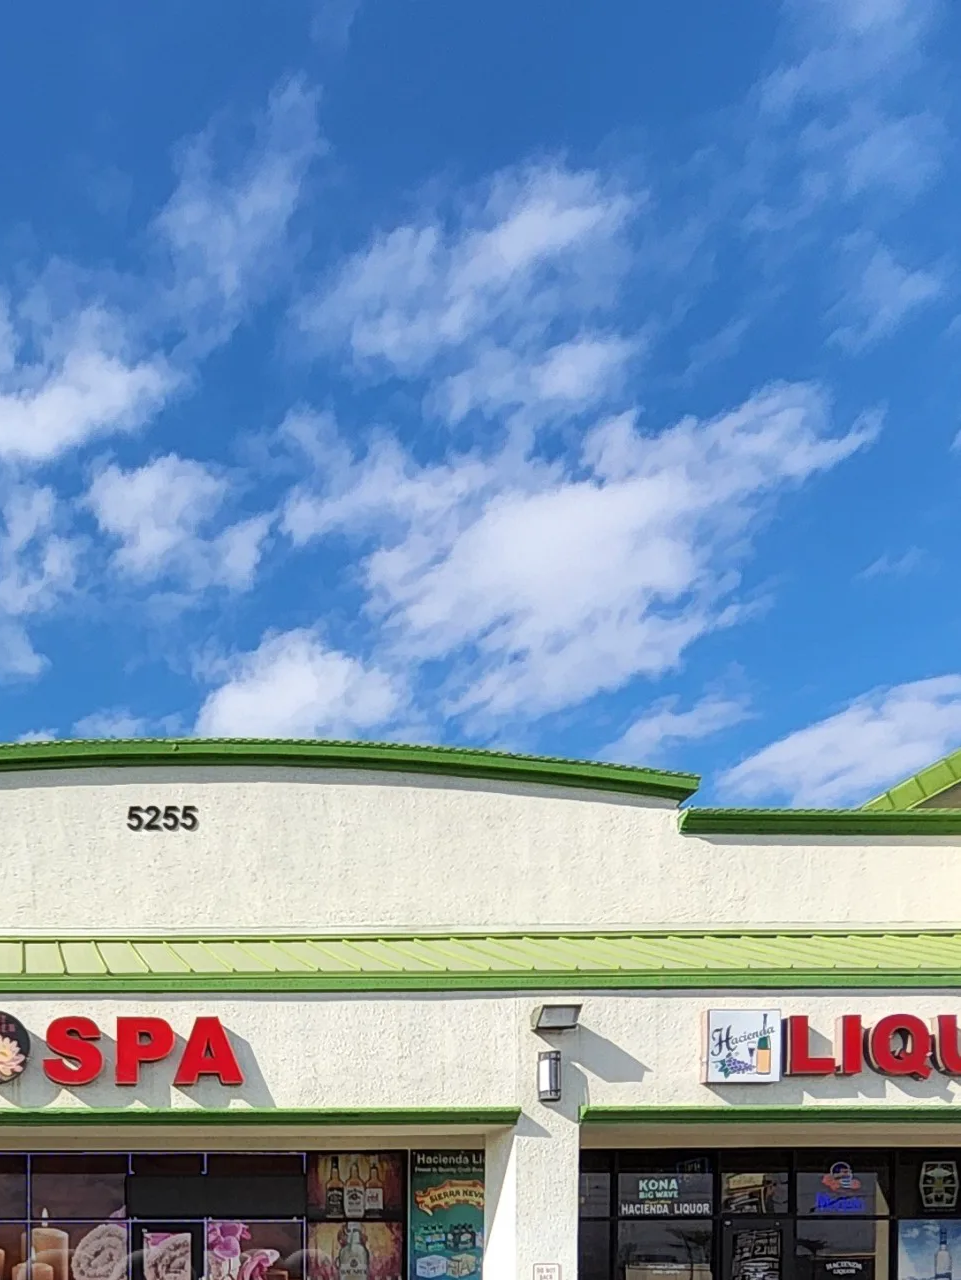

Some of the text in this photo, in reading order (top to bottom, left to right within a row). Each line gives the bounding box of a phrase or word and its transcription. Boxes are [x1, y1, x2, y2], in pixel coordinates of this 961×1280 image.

[126, 805, 200, 832] 5255
[710, 1024, 776, 1057] Hacienda
[42, 1016, 245, 1086] SPA
[416, 1152, 485, 1165] Hacienda Li
[638, 1179, 678, 1191] KONA
[621, 1203, 710, 1215] HACIENDA LIQUOR
